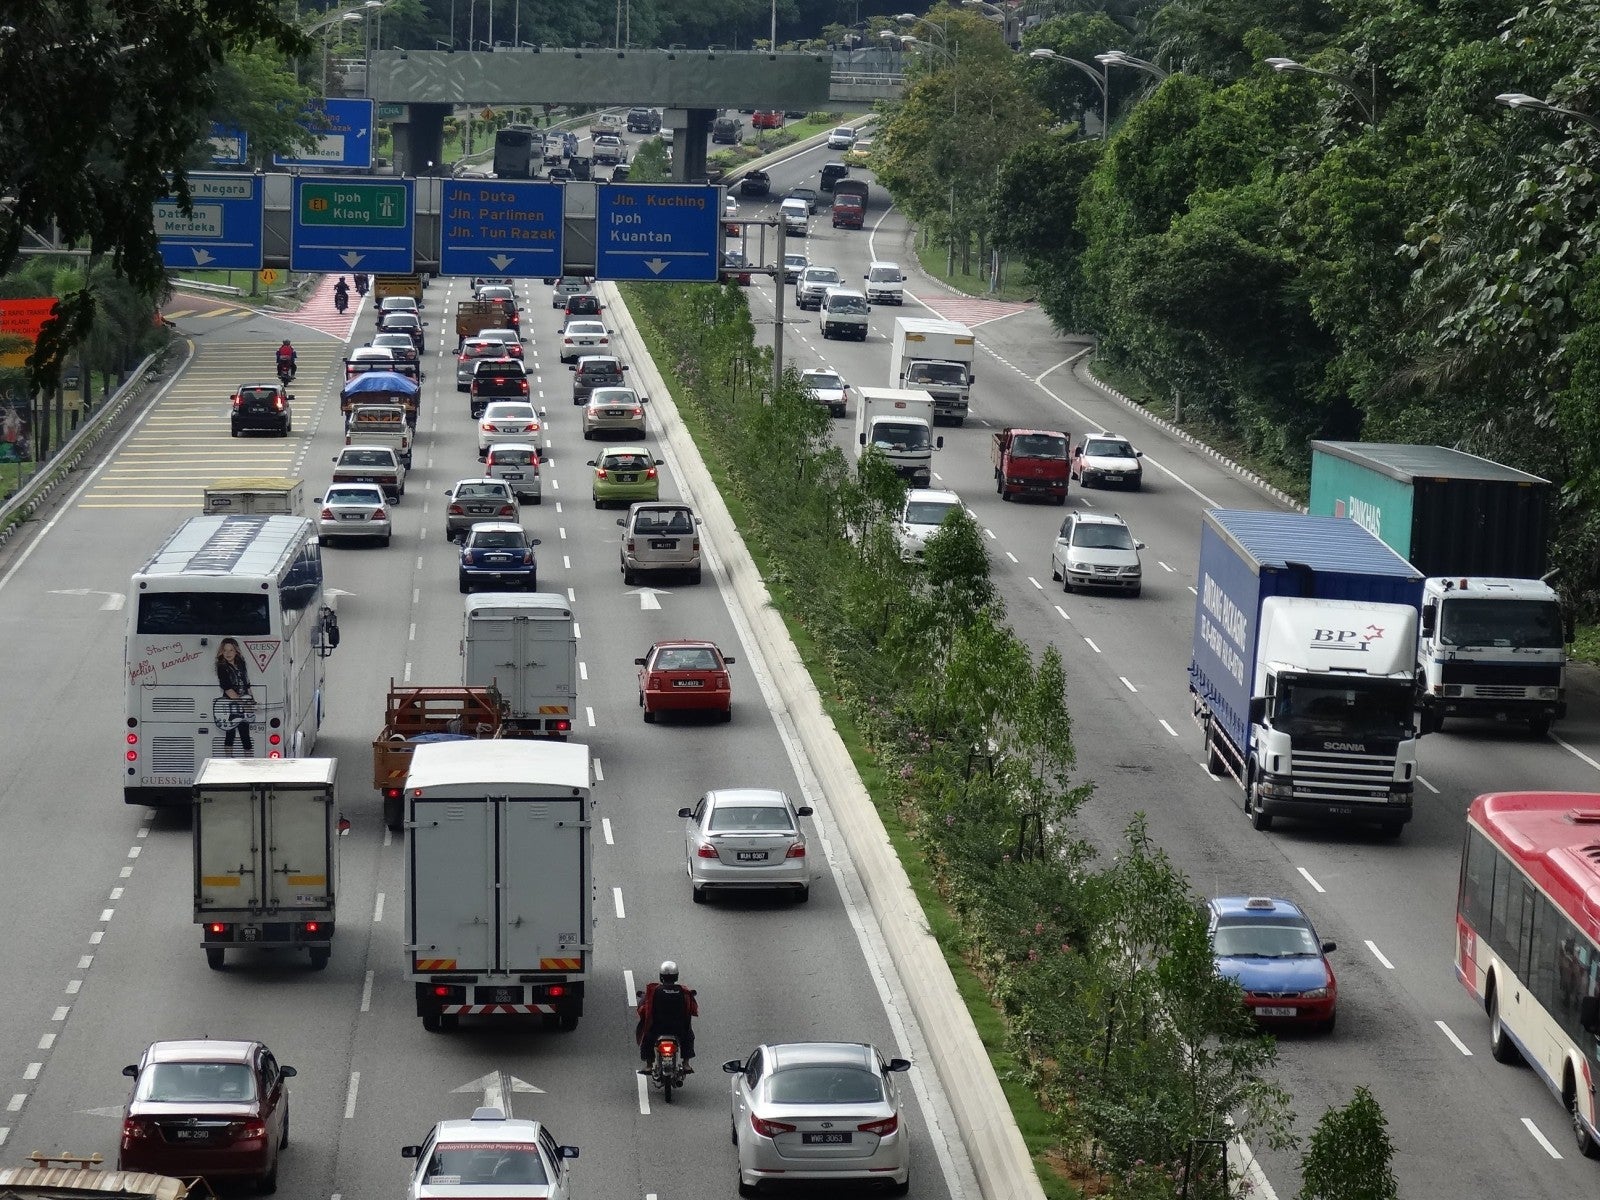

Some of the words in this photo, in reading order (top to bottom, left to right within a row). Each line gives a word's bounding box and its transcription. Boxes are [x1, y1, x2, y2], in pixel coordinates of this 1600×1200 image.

[203, 183, 246, 196] Negara
[334, 191, 361, 204] Ipoh
[480, 190, 515, 202] Duta
[647, 195, 705, 210] Kuching
[158, 209, 206, 220] Dataan
[333, 208, 370, 222] Klang
[480, 208, 544, 221] Parlimen
[611, 212, 641, 225] Ipoh
[165, 221, 215, 232] Merdeka
[448, 226, 474, 237] Jln.
[480, 226, 506, 238] Tun
[511, 227, 556, 240] Razak
[610, 230, 672, 242] Kuantan
[250, 643, 276, 651] GUESS
[1323, 741, 1366, 752] SCANIA
[495, 1144, 522, 1152] Property
